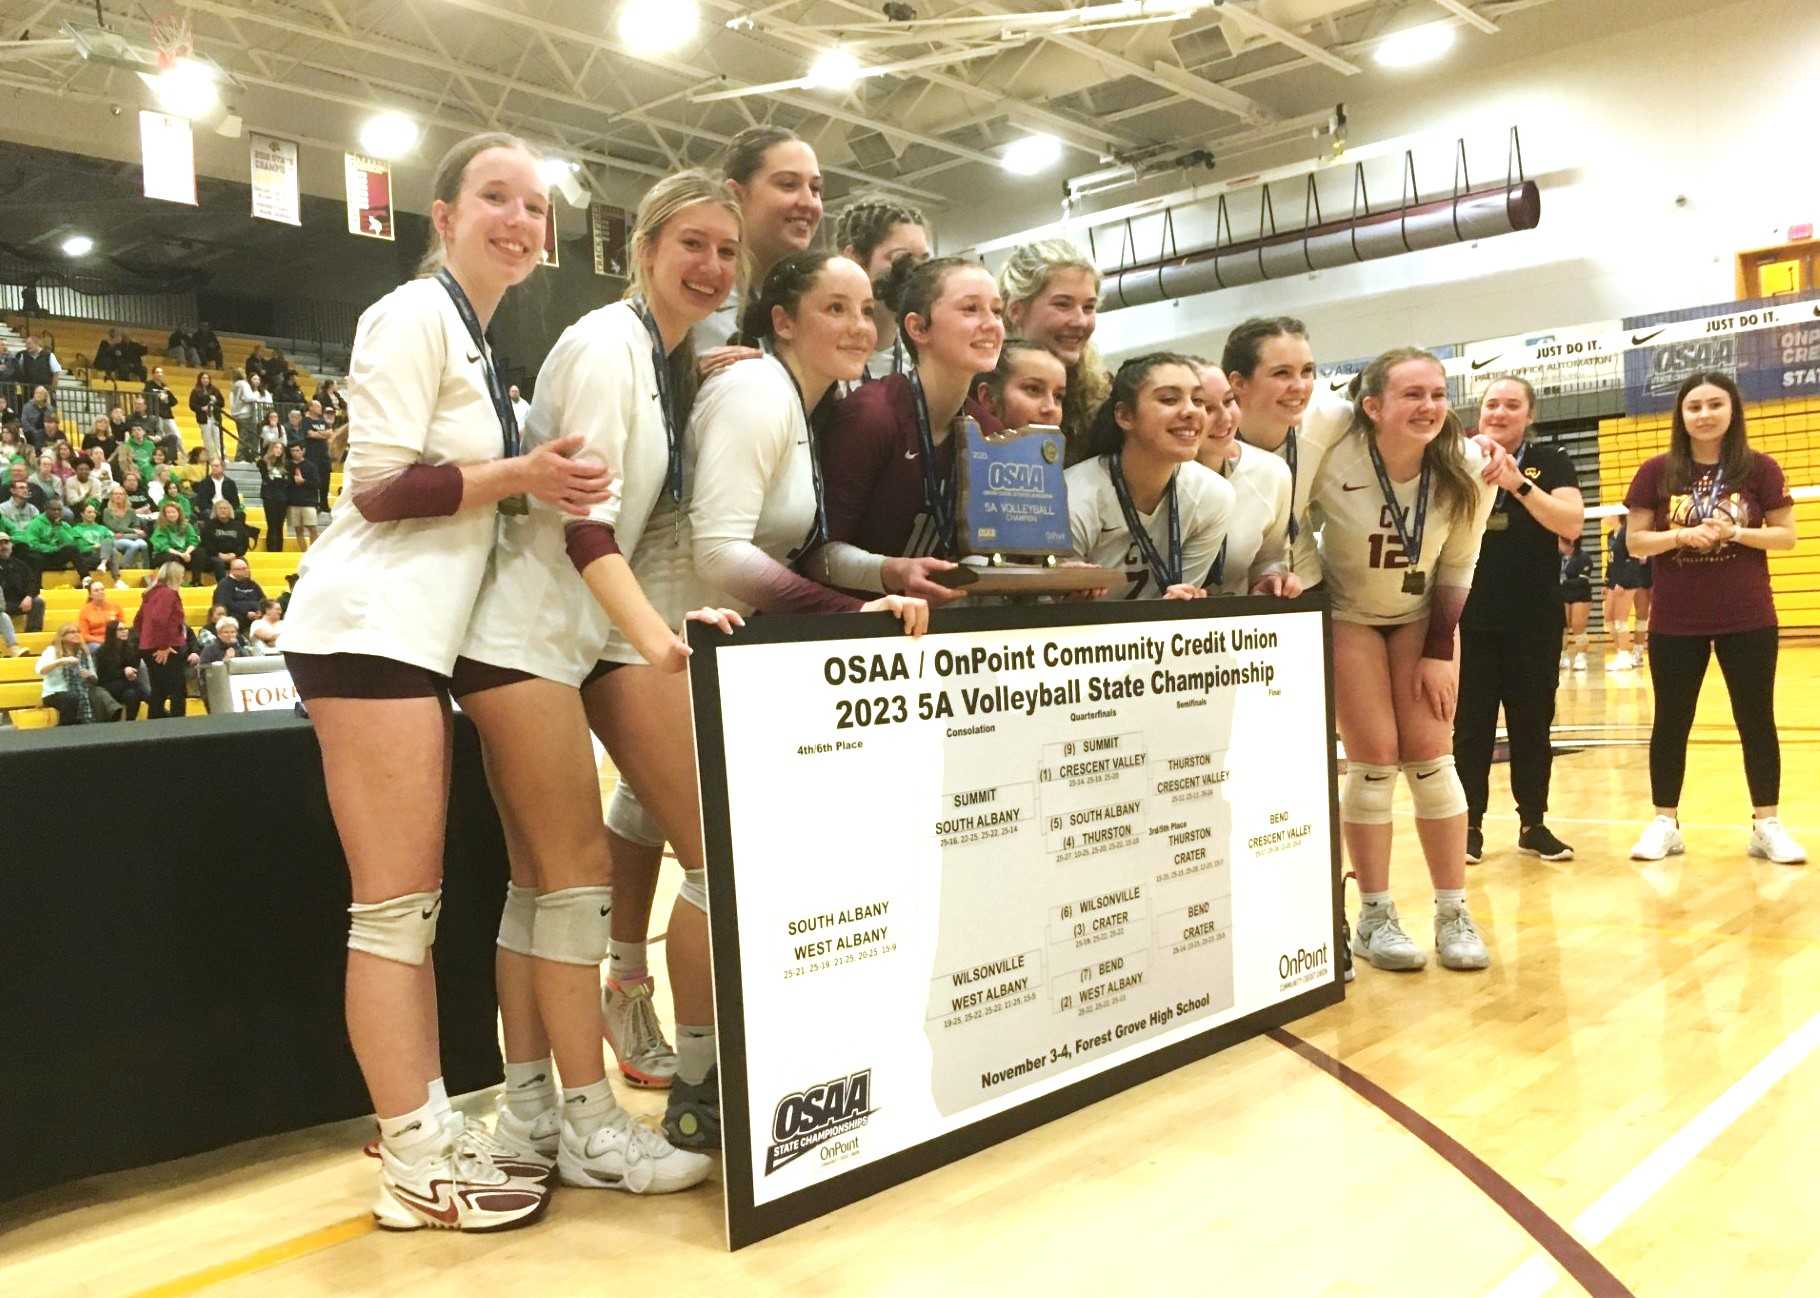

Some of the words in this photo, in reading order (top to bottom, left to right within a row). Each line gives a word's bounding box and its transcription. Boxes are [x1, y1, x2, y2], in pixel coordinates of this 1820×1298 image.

[1706, 317, 1734, 332] JUST
[1740, 314, 1758, 327] DO
[1763, 311, 1779, 323] IT.
[1536, 345, 1562, 359] JUST
[1567, 342, 1583, 355] DO
[1588, 340, 1602, 351] IT.
[988, 462, 1045, 492] OSAA
[1000, 503, 1056, 515] VOLLEYBALL
[1368, 533, 1413, 569] 12
[1125, 568, 1149, 600] 7
[824, 653, 910, 686] OSAA
[919, 650, 925, 679] /
[934, 644, 1036, 677] OnPoint
[1043, 636, 1165, 667] Community
[1171, 631, 1226, 657] Credit
[1231, 628, 1278, 651] Union
[835, 694, 908, 729] 2023
[918, 690, 954, 720] 5A
[961, 679, 1081, 716] Volleyball
[1088, 674, 1145, 702] State
[1151, 661, 1275, 695] Championship
[1176, 698, 1207, 709] Semifinals
[1070, 709, 1117, 722] Quarterfinals
[946, 724, 996, 738] Consolation
[797, 743, 833, 756] 4th/6th
[836, 739, 863, 751] Place
[1063, 743, 1076, 757] (9)
[1083, 737, 1119, 752] SUMMIT
[1040, 768, 1052, 783] (1)
[1060, 759, 1110, 778] CRESCENT
[1112, 753, 1146, 769] VALLEY
[1168, 754, 1211, 771] THURSTON
[1157, 776, 1200, 793] CRESCENT
[1202, 770, 1230, 786] VALLEY
[954, 788, 997, 808] SUMMIT
[935, 816, 974, 834] SOUTH
[977, 808, 1020, 828] ALBANY
[1050, 817, 1063, 831] (5)
[1070, 808, 1103, 826] SOUTH
[1104, 800, 1141, 819] ALBANY
[1170, 822, 1187, 831] Place
[1269, 811, 1289, 824] BEND
[1063, 836, 1075, 850] (4)
[1082, 824, 1131, 845] THURSTON
[1168, 827, 1212, 846] THURSTON
[1248, 830, 1285, 849] CRESCENT
[1287, 824, 1312, 839] VALLEY
[1174, 848, 1206, 865] CRATER
[1061, 905, 1073, 920] (6)
[1080, 886, 1141, 913] WILSONVILLE
[1187, 902, 1210, 918] BEND
[788, 912, 834, 936] SOUTH
[838, 900, 889, 925] ALBANY
[1074, 923, 1086, 938] (3)
[1092, 911, 1129, 931] CRATER
[1183, 921, 1214, 940] CRATER
[794, 939, 833, 961] WEST
[836, 926, 888, 951] ALBANY
[952, 955, 1025, 987] WILSONVILLE
[1080, 969, 1092, 983] (7)
[1099, 957, 1124, 976] BEND
[1279, 941, 1327, 979] OnPoint
[951, 991, 984, 1011] WEST
[986, 977, 1029, 1001] ALBANY
[1061, 995, 1073, 1010] (2)
[1079, 984, 1105, 1004] WEST
[1107, 972, 1143, 993] ALBANY
[981, 1055, 1046, 1088] November
[1049, 1044, 1072, 1064] 3-4,
[1075, 1029, 1112, 1053] Forest
[1115, 1019, 1147, 1039] Grove
[1149, 1006, 1174, 1026] High
[1176, 993, 1211, 1016] School
[772, 1068, 872, 1144] OSAA
[773, 1139, 800, 1157] STATE
[800, 1116, 869, 1147] CHAMPIONSHIPS
[820, 1136, 859, 1161] OnPoint
